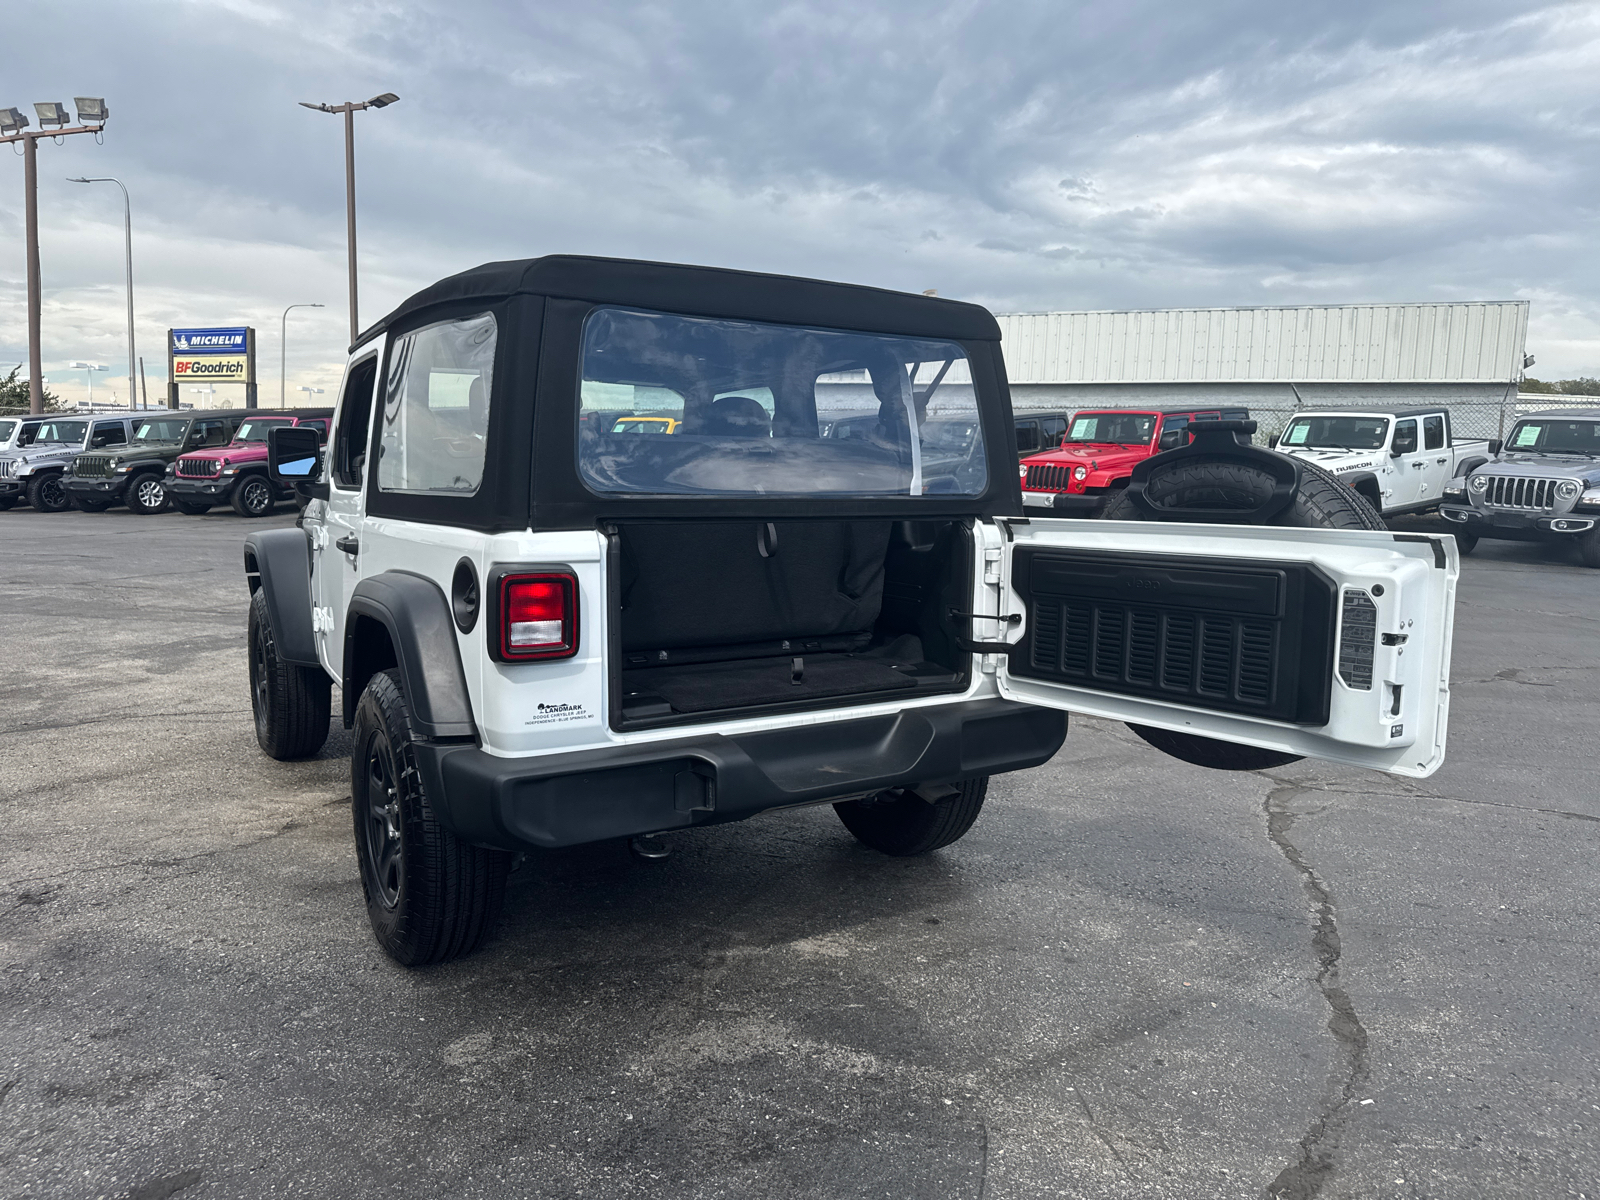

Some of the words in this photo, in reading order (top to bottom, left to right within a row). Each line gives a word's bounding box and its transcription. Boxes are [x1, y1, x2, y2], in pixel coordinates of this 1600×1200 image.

[190, 335, 243, 345] MICHELIN
[175, 361, 244, 374] BFGoodrich
[1335, 461, 1372, 473] RUBICON
[544, 704, 583, 714] LANDMARK
